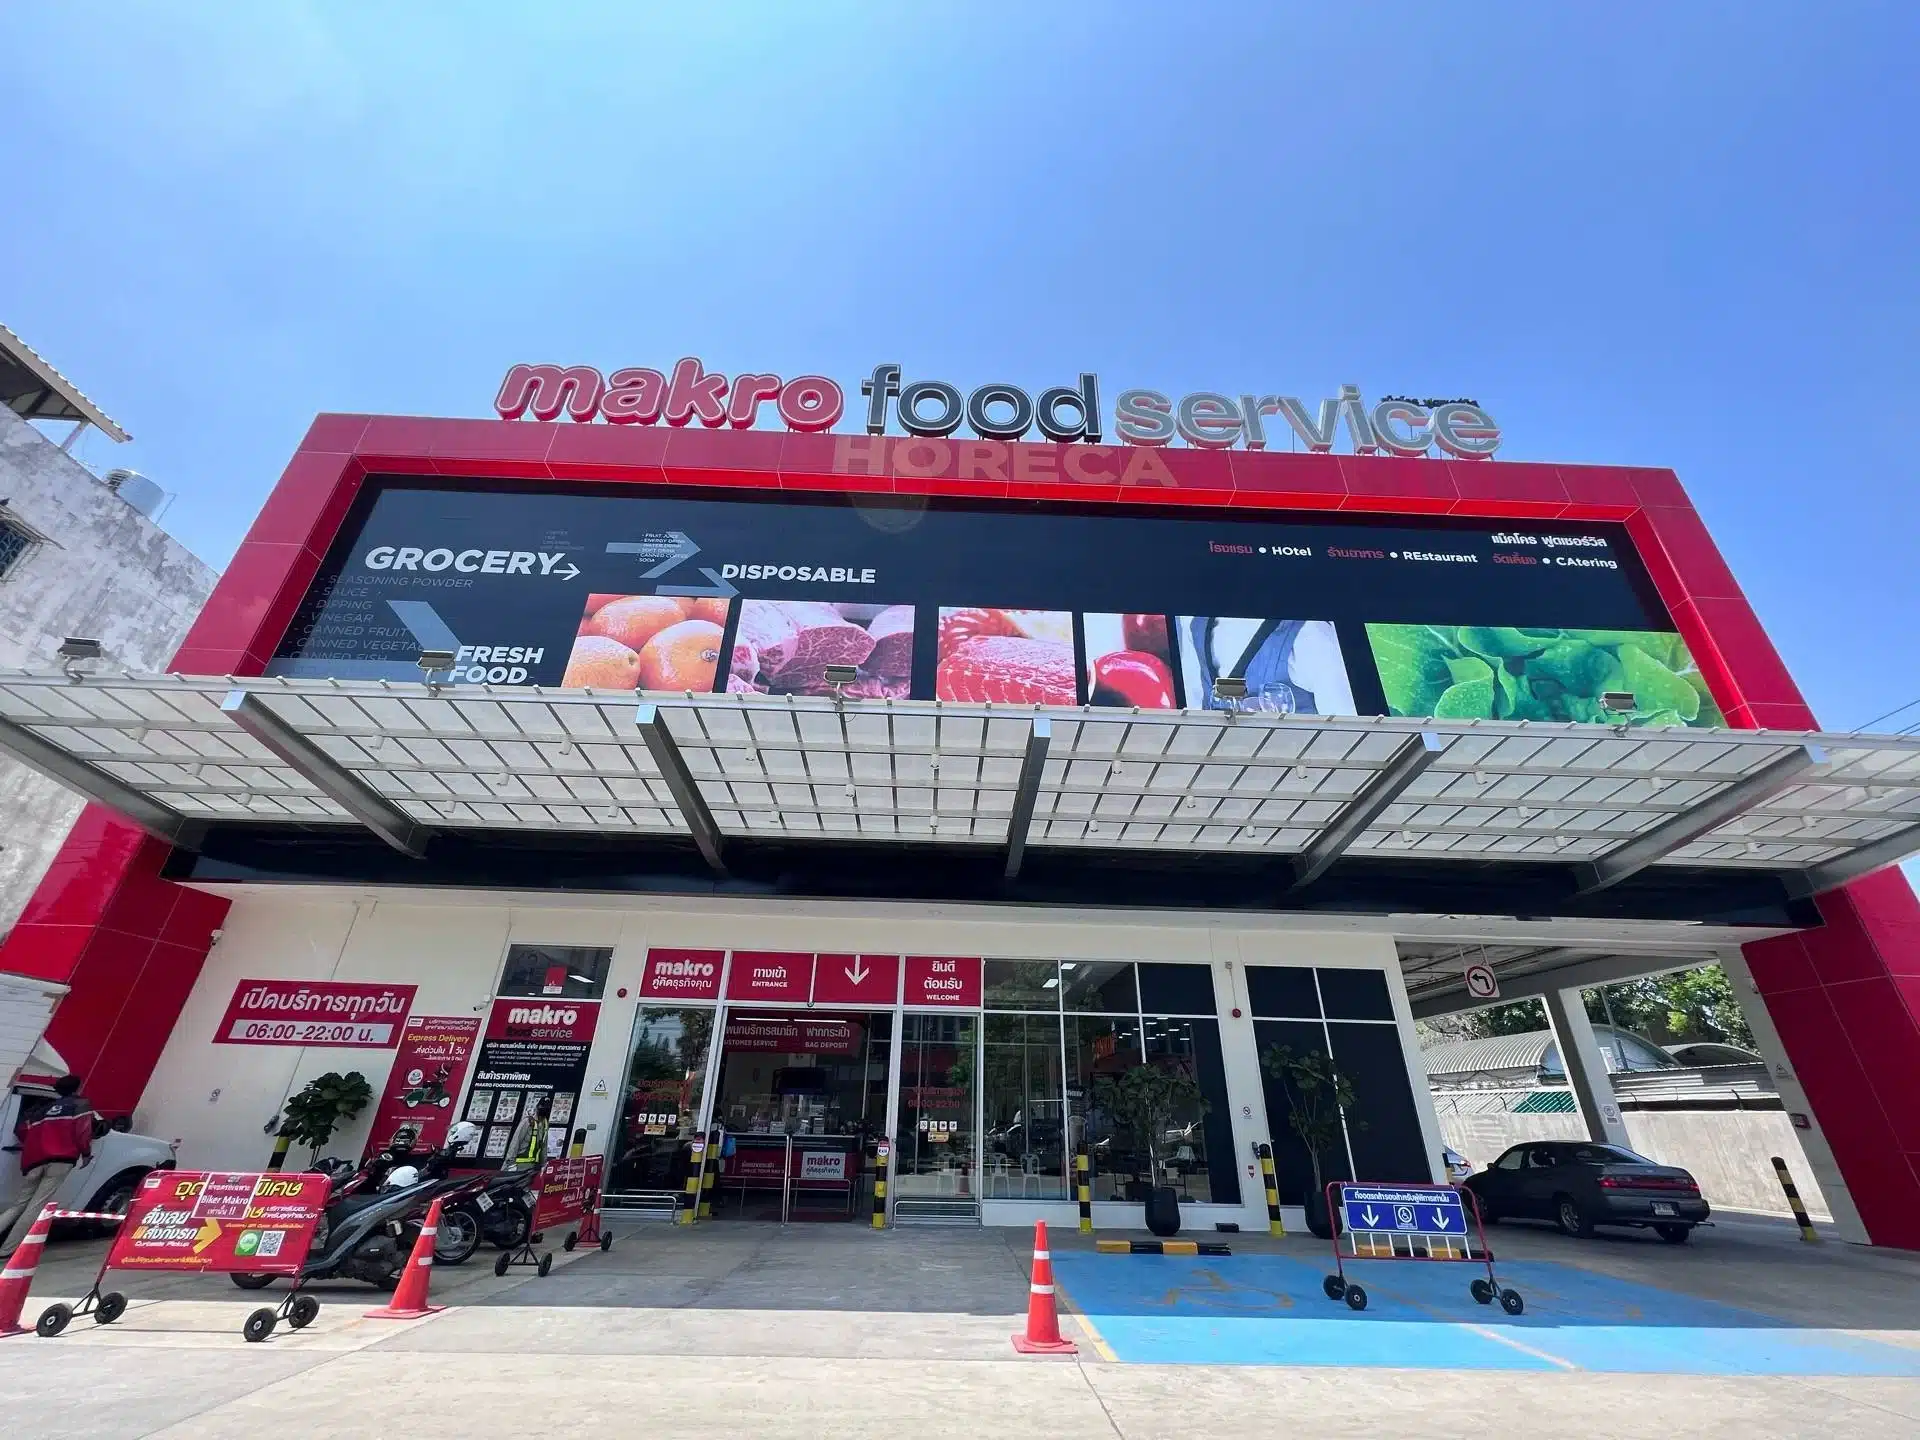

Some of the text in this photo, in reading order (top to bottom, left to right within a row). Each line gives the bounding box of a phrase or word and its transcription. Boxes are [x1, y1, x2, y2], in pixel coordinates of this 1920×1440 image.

[494, 357, 1500, 460] makro food service
[832, 433, 1179, 488] HORECA
[1271, 546, 1312, 557] HOtel
[1403, 550, 1478, 563] REstaurant
[365, 546, 566, 575] GROCERY
[1556, 557, 1618, 570] CAtering
[721, 563, 877, 584] DISPOSABLE
[328, 574, 474, 589] SEASONING POWDER
[323, 586, 369, 597] SAUCE
[316, 600, 373, 610] DIPPING
[311, 612, 375, 623] VINEGAR
[303, 624, 364, 636] CANNED
[297, 637, 358, 649] CANNED
[455, 645, 545, 664] FRESH
[448, 665, 528, 684] FOOD
[655, 959, 714, 976] makro
[753, 965, 787, 978] ทางเข้า
[931, 960, 955, 973] ยินดี
[652, 976, 712, 990] คู่คิดธุรกิจคุณ
[752, 980, 788, 988] ENTRANCE
[923, 976, 963, 990] ต้อนรับ
[239, 987, 406, 1020] เปิดบริการทุกวัน
[508, 1004, 578, 1026] makro
[245, 1023, 355, 1041] 06:00-22:00
[358, 1027, 374, 1042] น.
[408, 1034, 470, 1044] Express Delivery
[807, 1156, 841, 1166] makro
[201, 1195, 249, 1204] Biker Makro
